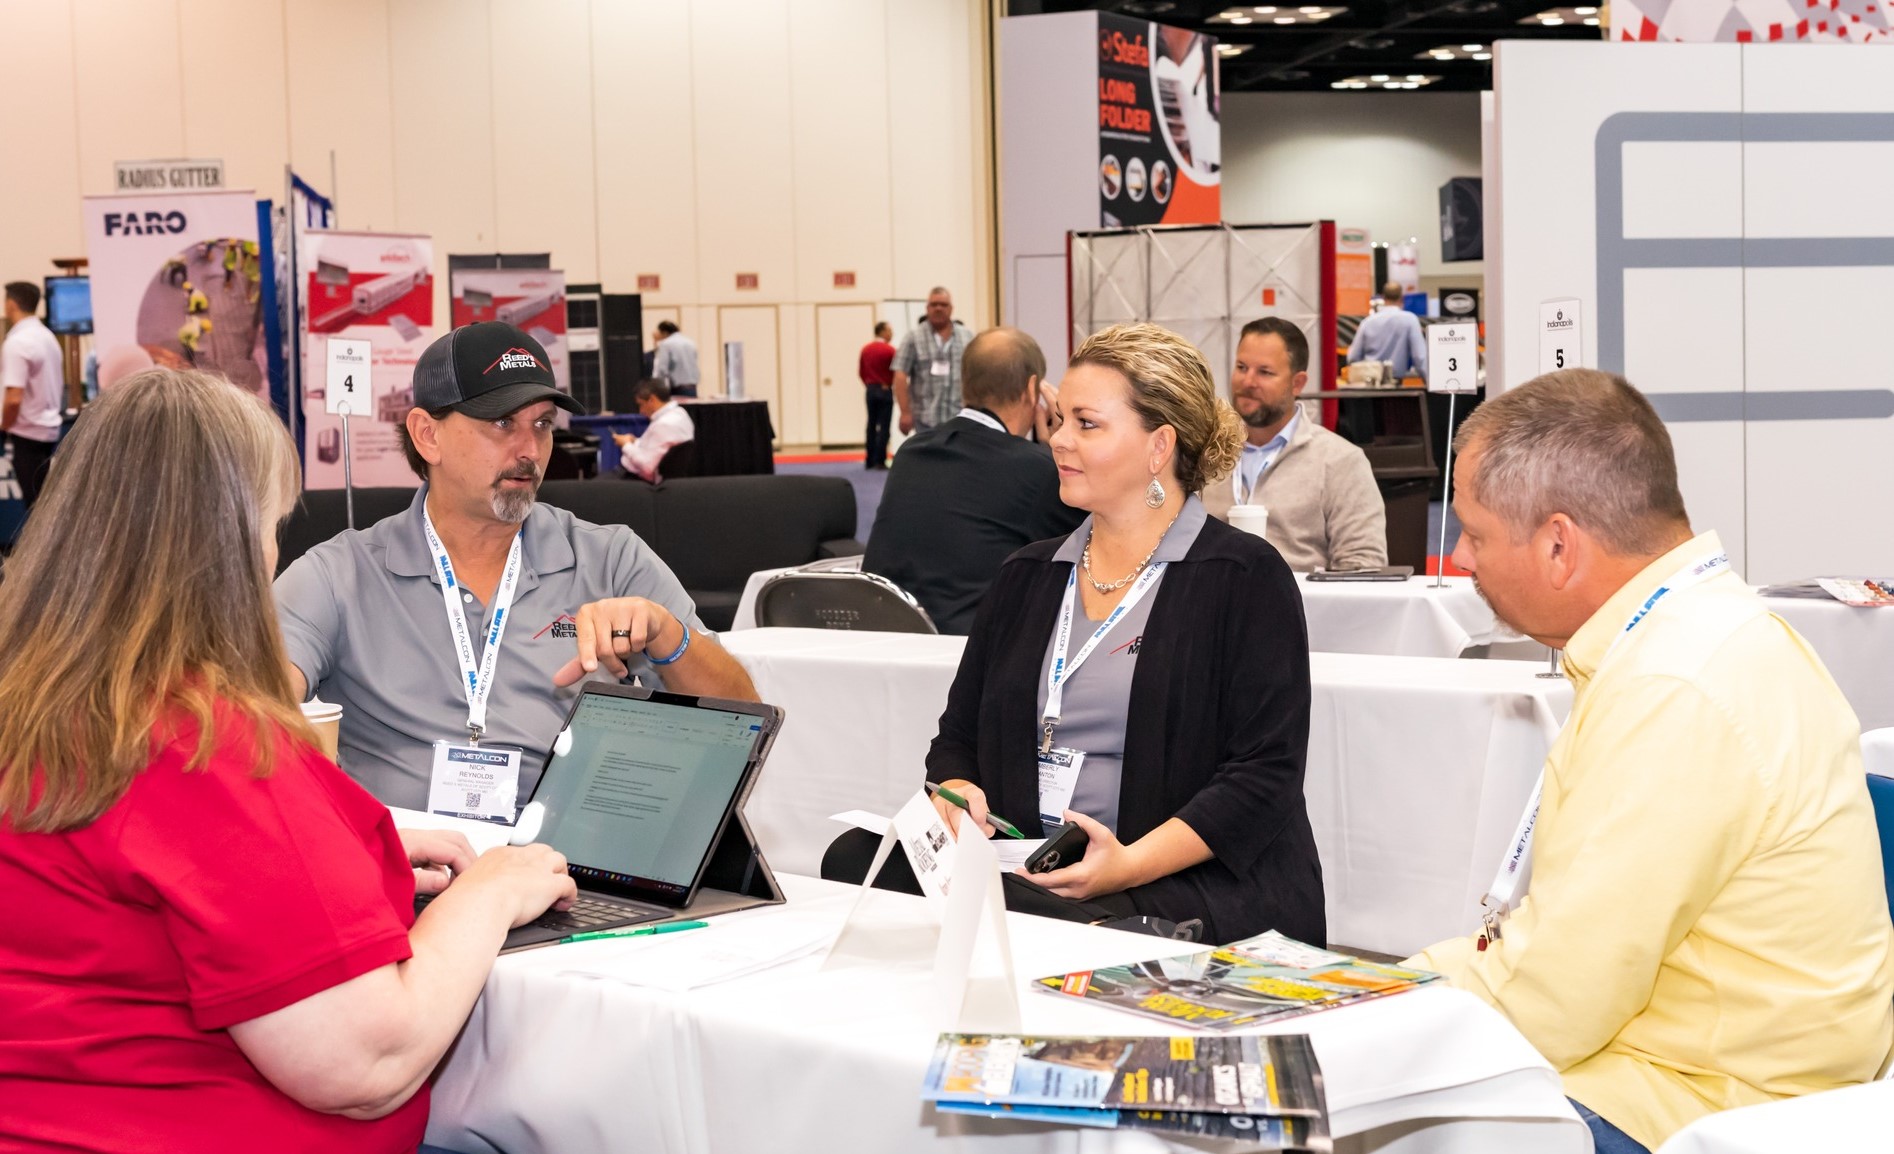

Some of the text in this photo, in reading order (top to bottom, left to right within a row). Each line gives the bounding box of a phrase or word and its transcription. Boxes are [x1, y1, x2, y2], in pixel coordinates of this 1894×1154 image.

[1100, 77, 1136, 105] LONG
[1100, 104, 1151, 132] FOLDER
[118, 167, 220, 188] RADIUS GUTTER
[104, 211, 187, 236] FARO
[1448, 358, 1457, 371] 3
[1556, 349, 1564, 368] 5
[344, 375, 354, 393] 4
[551, 628, 578, 639] META
[552, 621, 576, 631] REE
[455, 617, 470, 664] METALCON
[461, 753, 507, 763] METALCON
[459, 771, 494, 780] REYNOLDS
